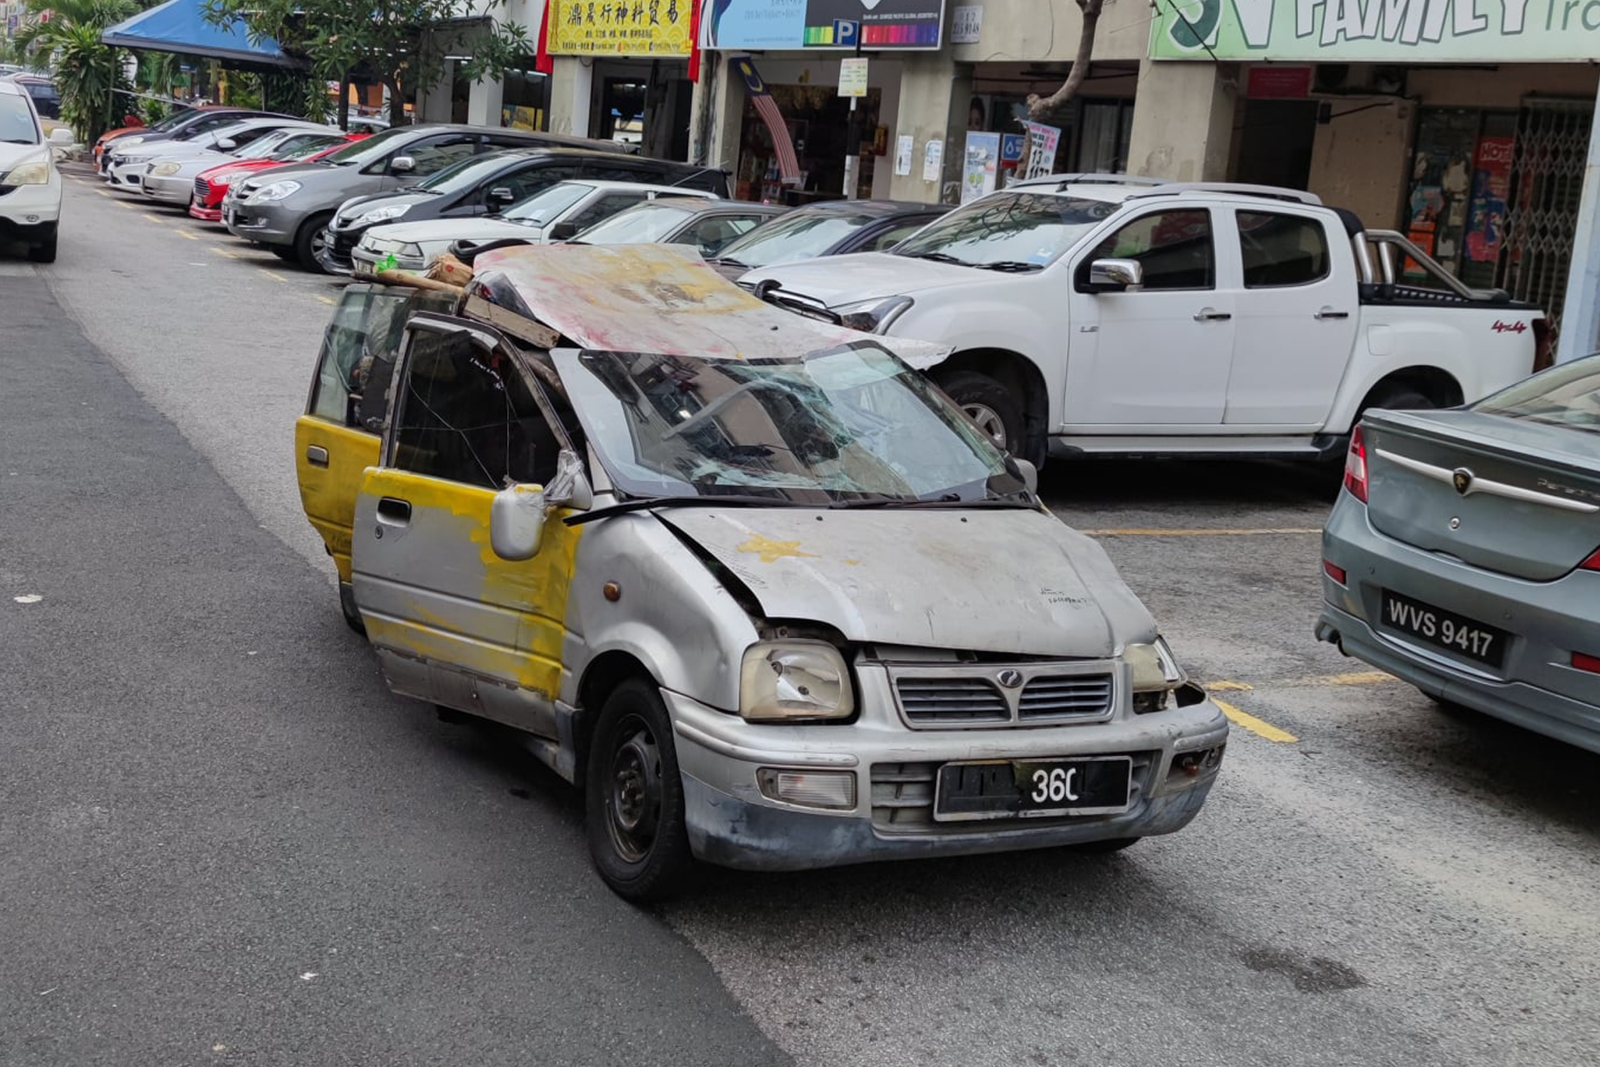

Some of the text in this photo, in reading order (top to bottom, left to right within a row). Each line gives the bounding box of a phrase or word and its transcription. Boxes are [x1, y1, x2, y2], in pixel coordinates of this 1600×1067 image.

[837, 22, 853, 44] P
[1491, 319, 1528, 334] 4x4
[1389, 599, 1494, 656] WVS 9417
